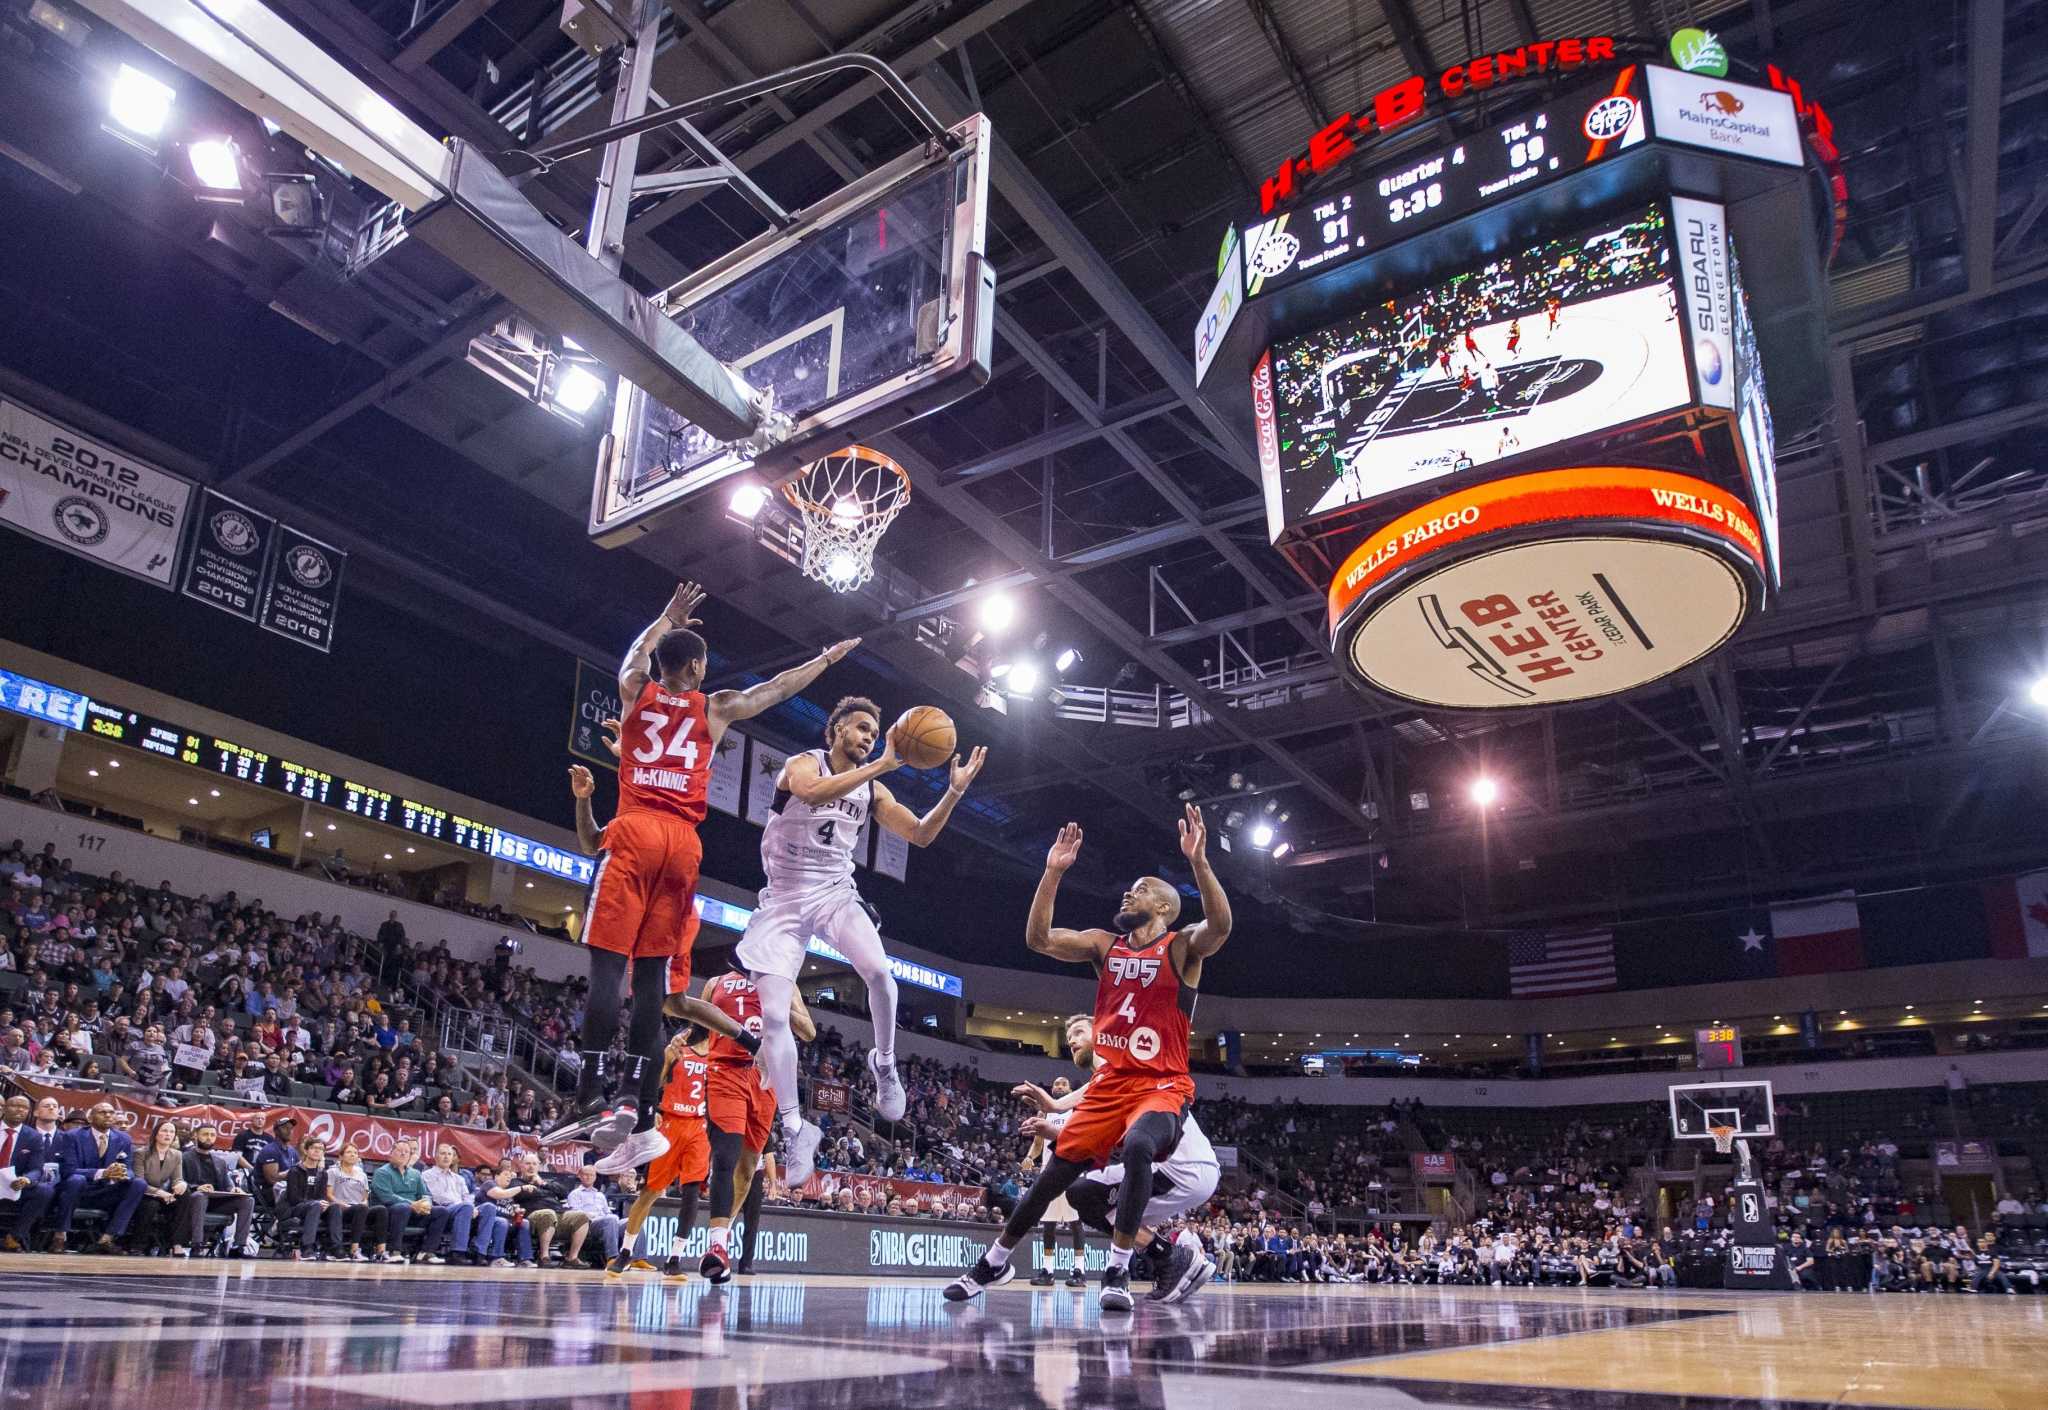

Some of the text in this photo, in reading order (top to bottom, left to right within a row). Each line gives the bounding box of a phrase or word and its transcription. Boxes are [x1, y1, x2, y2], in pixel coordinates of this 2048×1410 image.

[1440, 36, 1615, 96] CENTER
[1535, 113, 1548, 130] 4
[1678, 108, 1770, 137] PlainsCapital
[1709, 127, 1743, 145] Bank
[1510, 136, 1544, 168] 89
[1379, 146, 1465, 197] Quarter 4
[1342, 195, 1352, 211] 2
[1389, 183, 1442, 223] 3:38
[1323, 215, 1348, 244] 91
[1688, 218, 1714, 332] SUBARU
[1710, 223, 1729, 336] GEORGETOWN
[1, 431, 177, 514] NBA DEVELOPMENT LEAGUE
[51, 437, 140, 489] 2012
[0, 442, 175, 528] CHAMPIONS
[1651, 488, 1724, 522] WELLS
[1346, 505, 1481, 590] WELLS FARGO
[196, 565, 255, 595] CHAMPIONS
[206, 560, 249, 584] DIVISION
[198, 581, 247, 609] 2015
[282, 595, 322, 616] DIVISION
[1576, 590, 1606, 618] PARK
[274, 600, 328, 627] CHAMPIONS
[274, 614, 321, 640] 2016
[1527, 590, 1604, 662] CENTER
[1594, 614, 1625, 642] CEDAR
[186, 735, 200, 750] 91
[632, 710, 698, 769] 34
[632, 767, 690, 792] McKINNIE
[78, 834, 105, 851] 117
[817, 820, 836, 845] 4
[533, 848, 573, 875] ONE
[1108, 957, 1162, 988] 905
[736, 997, 744, 1016] 1
[1118, 992, 1137, 1024] 4
[1096, 1032, 1128, 1050] BMO
[1709, 1029, 1734, 1041] 3:38
[690, 1081, 702, 1099] 2
[674, 1103, 696, 1113] BMO
[882, 1231, 906, 1265] NBA
[907, 1234, 926, 1266] G
[925, 1234, 964, 1267] LEAGUE
[1745, 1255, 1774, 1268] FINALS
